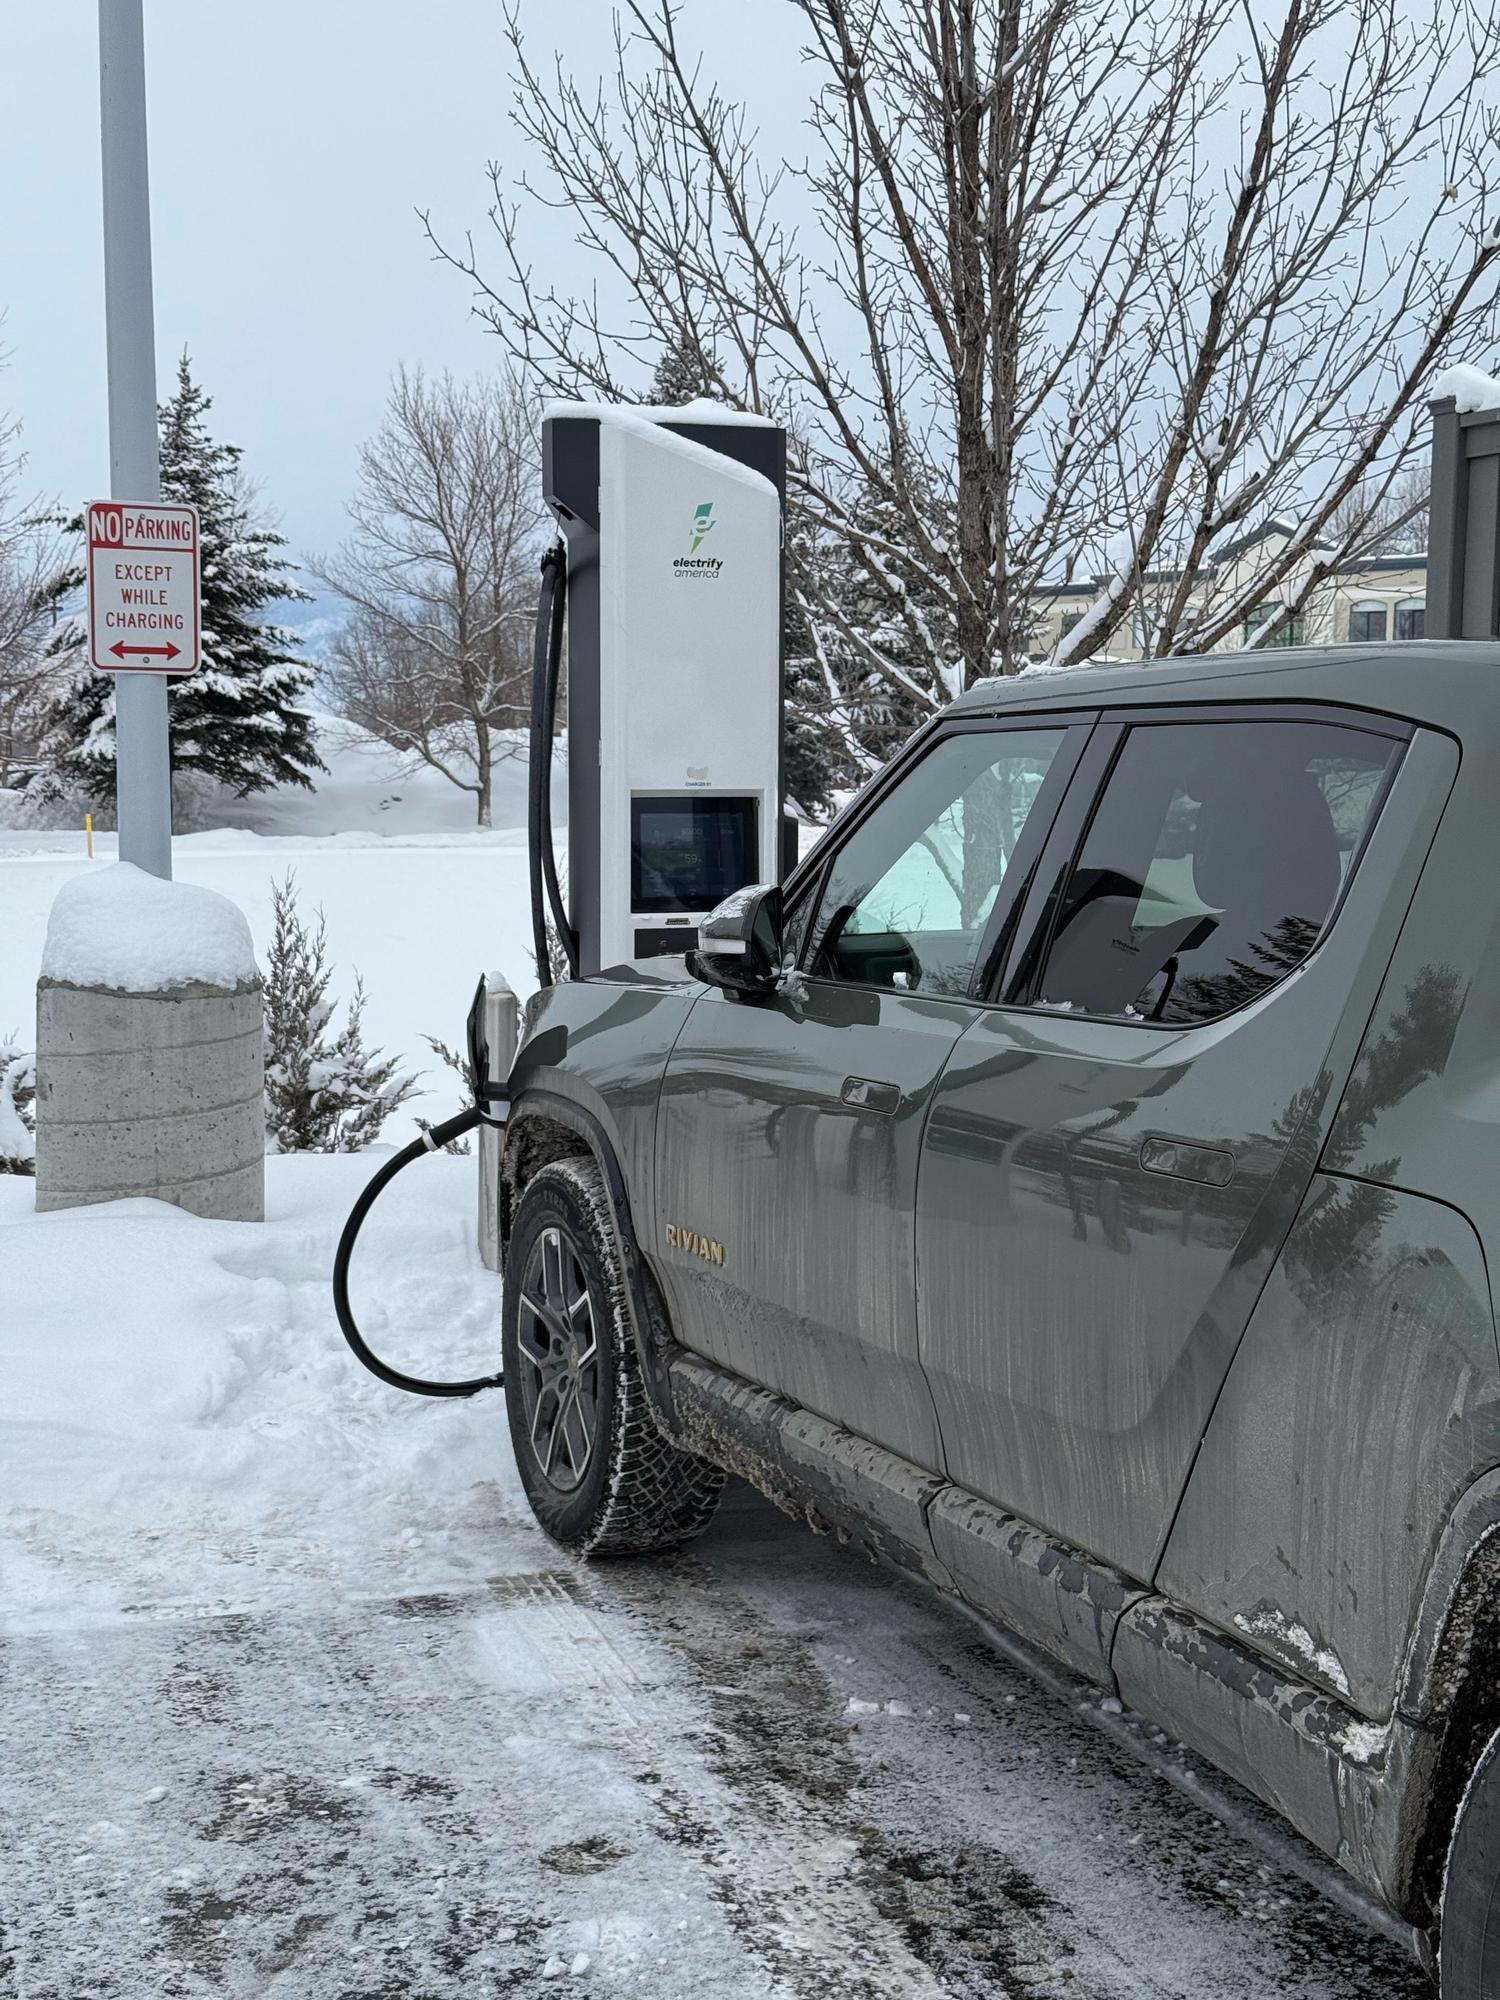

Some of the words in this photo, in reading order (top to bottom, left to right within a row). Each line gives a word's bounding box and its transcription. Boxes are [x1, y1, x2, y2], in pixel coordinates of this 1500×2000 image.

[91, 511, 121, 543] NO
[125, 517, 191, 541] PARKING
[673, 557, 723, 570] electrify
[115, 564, 173, 582] EXCEPT
[674, 568, 719, 579] america
[121, 588, 168, 606] WHILE
[105, 611, 184, 630] CHARGING
[665, 1223, 725, 1265] RIVIAN
